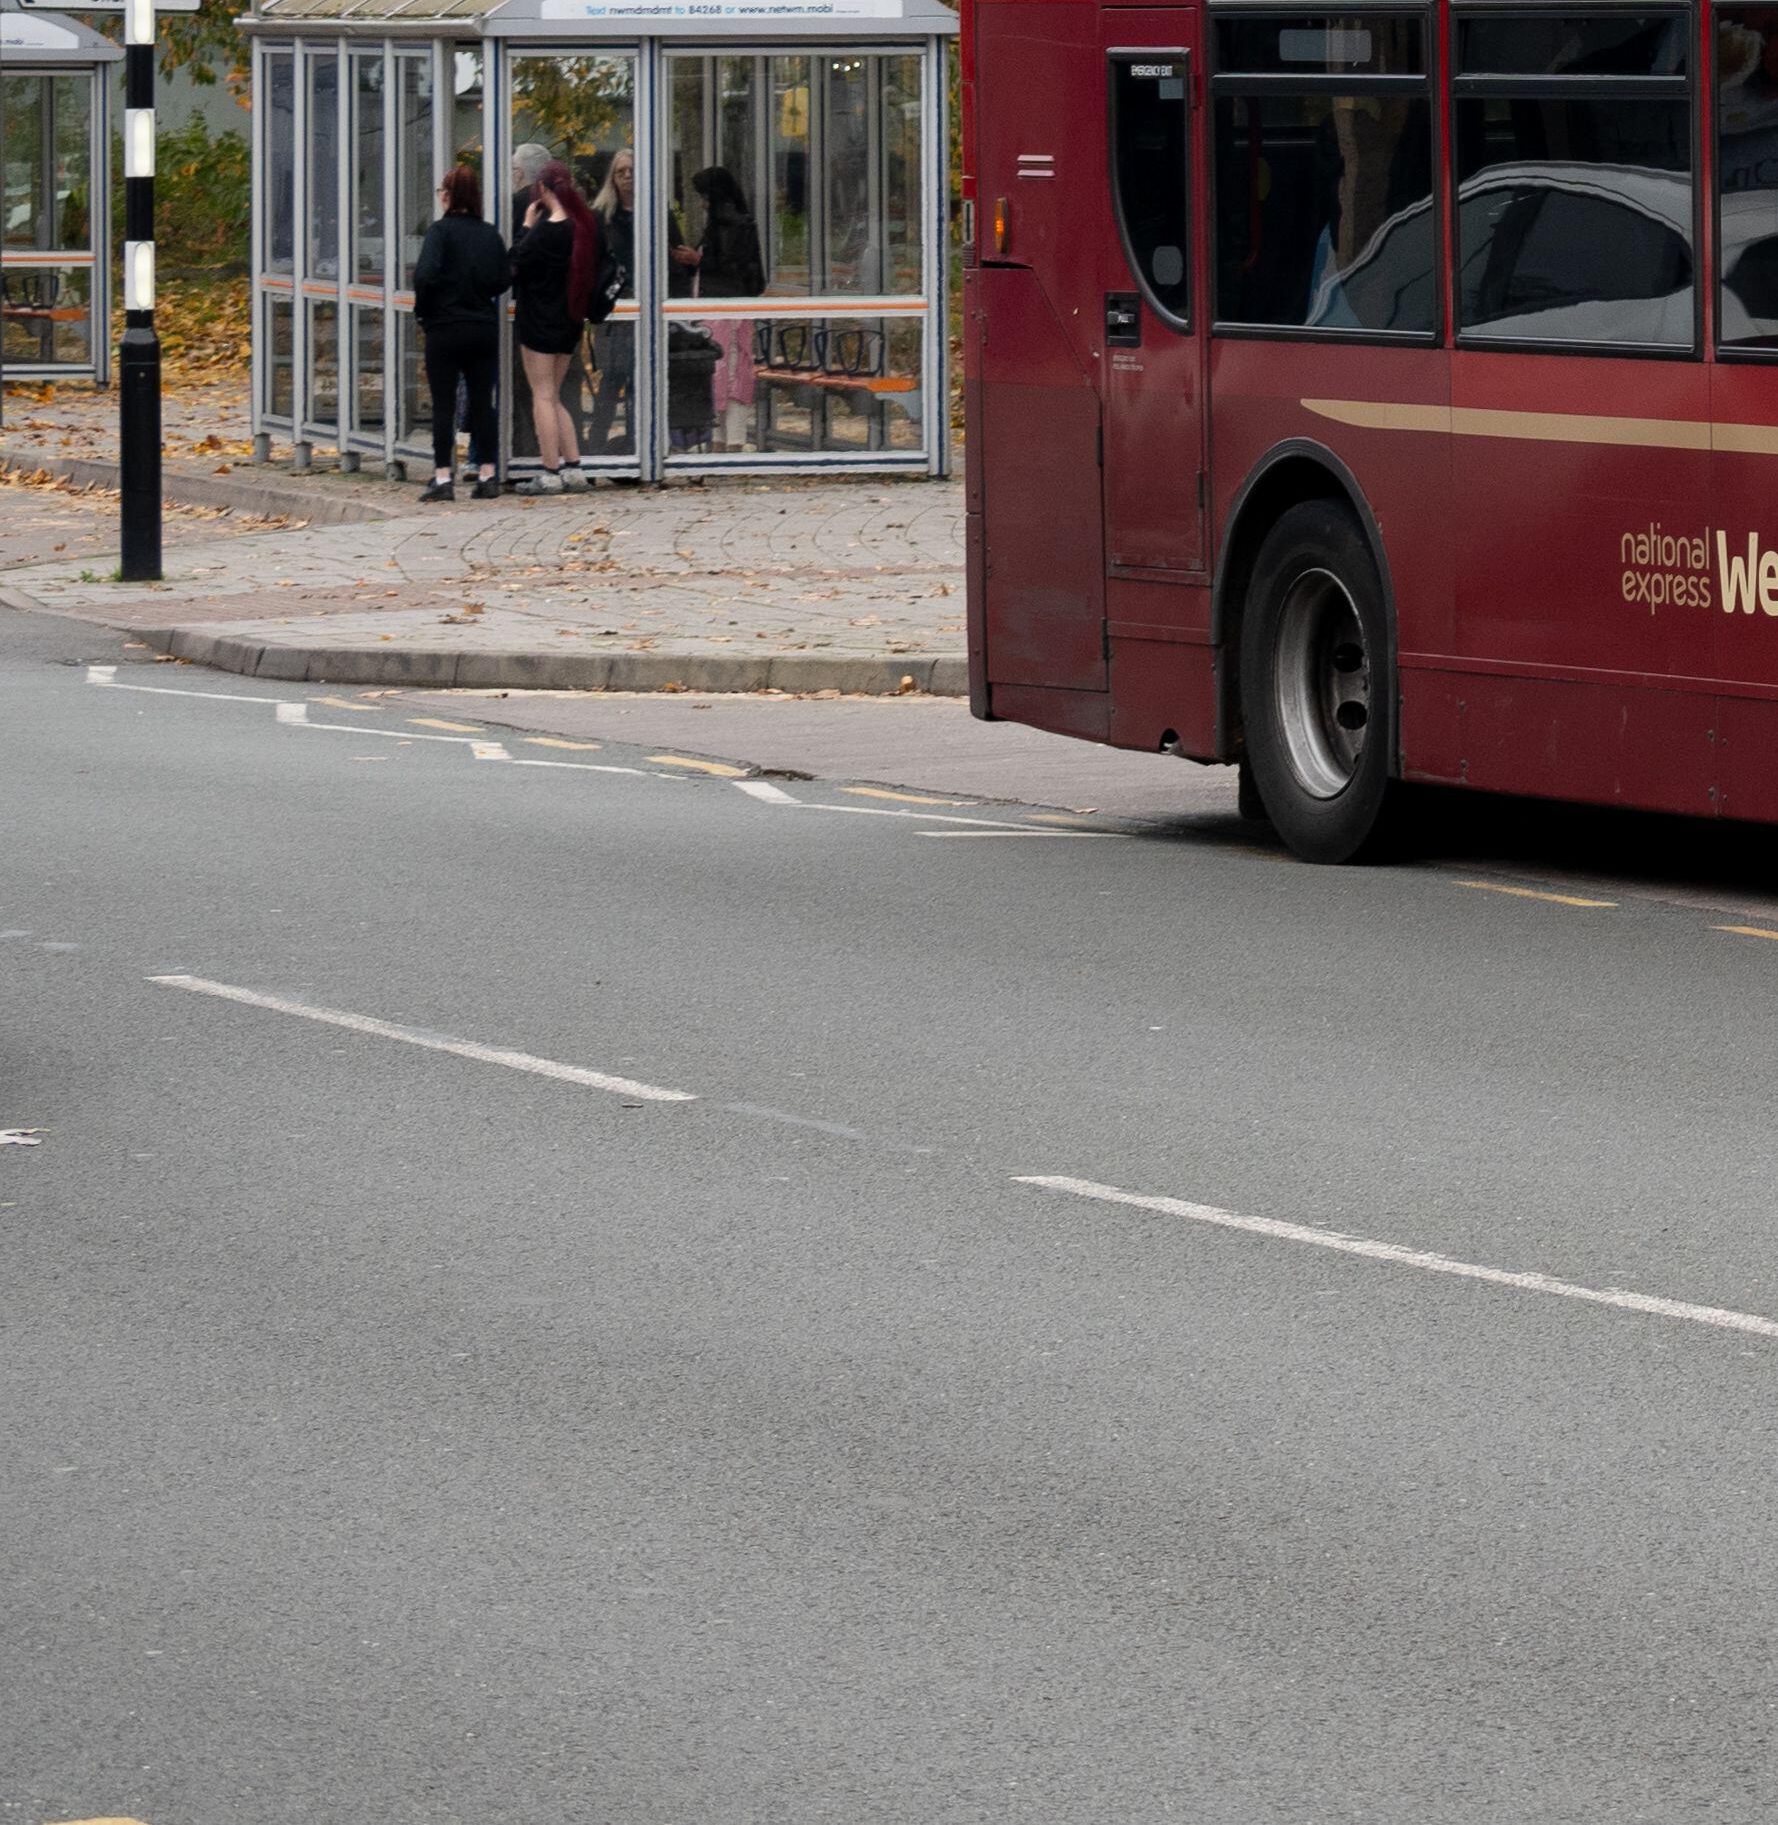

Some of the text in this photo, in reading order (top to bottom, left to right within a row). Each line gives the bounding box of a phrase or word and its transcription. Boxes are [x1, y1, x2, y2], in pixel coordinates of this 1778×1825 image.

[688, 5, 722, 15] 84268
[1621, 522, 1709, 570] national
[1621, 569, 1711, 615] express
